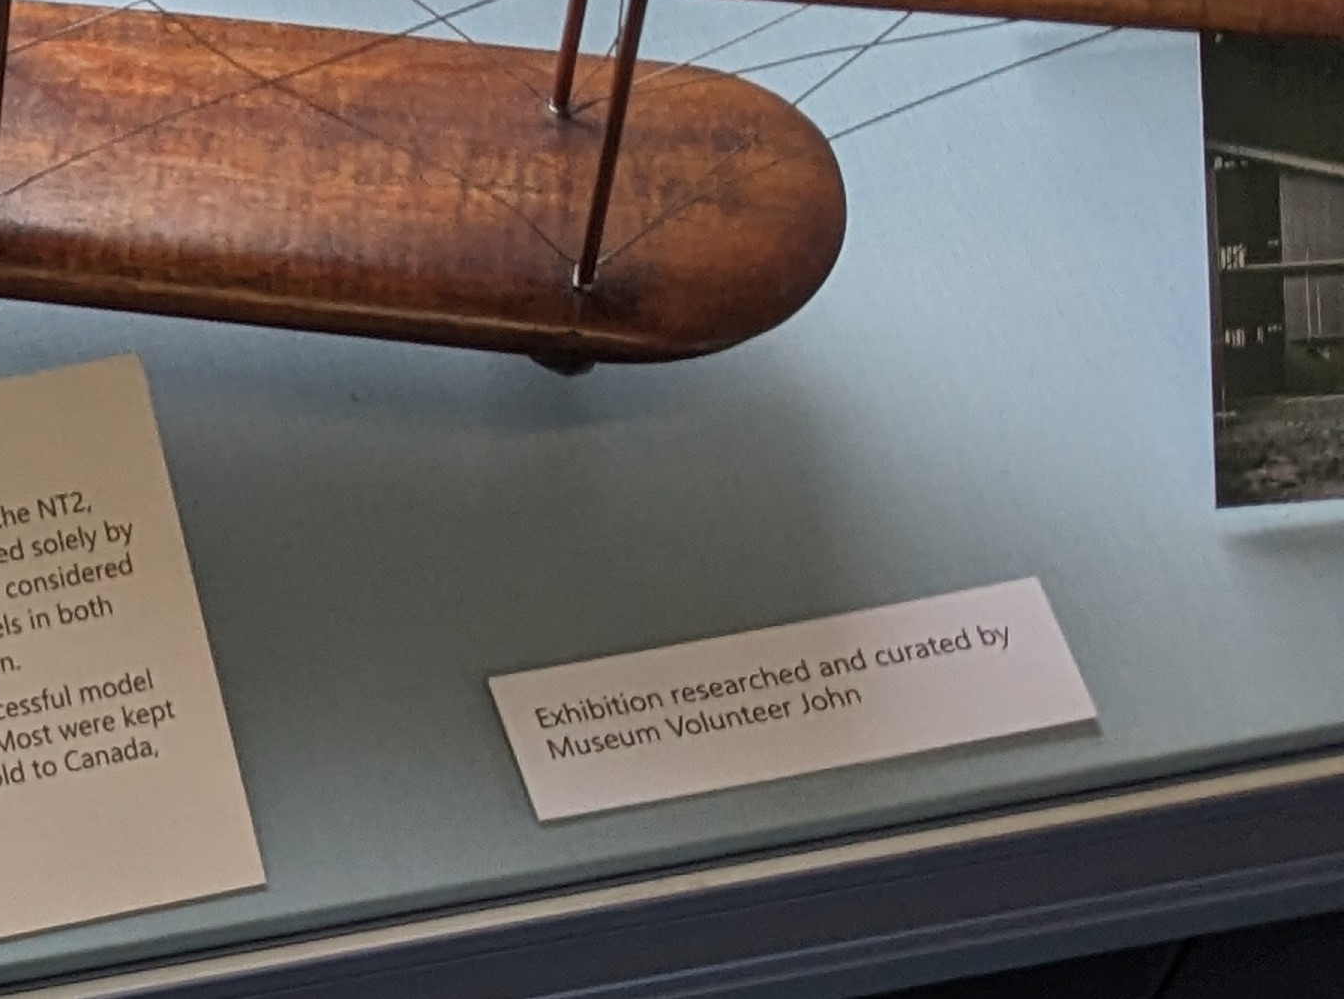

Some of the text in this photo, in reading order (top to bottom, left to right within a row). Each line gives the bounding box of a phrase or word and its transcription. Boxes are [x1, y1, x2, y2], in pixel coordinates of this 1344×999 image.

[35, 490, 92, 521] NT2,
[30, 525, 98, 558] solely
[102, 520, 134, 548] by
[4, 552, 134, 600] considered
[26, 608, 51, 630] in
[54, 594, 114, 625] both
[533, 625, 1009, 730] Exhibition researched and curated by
[545, 684, 862, 760] Museum Volunteer John
